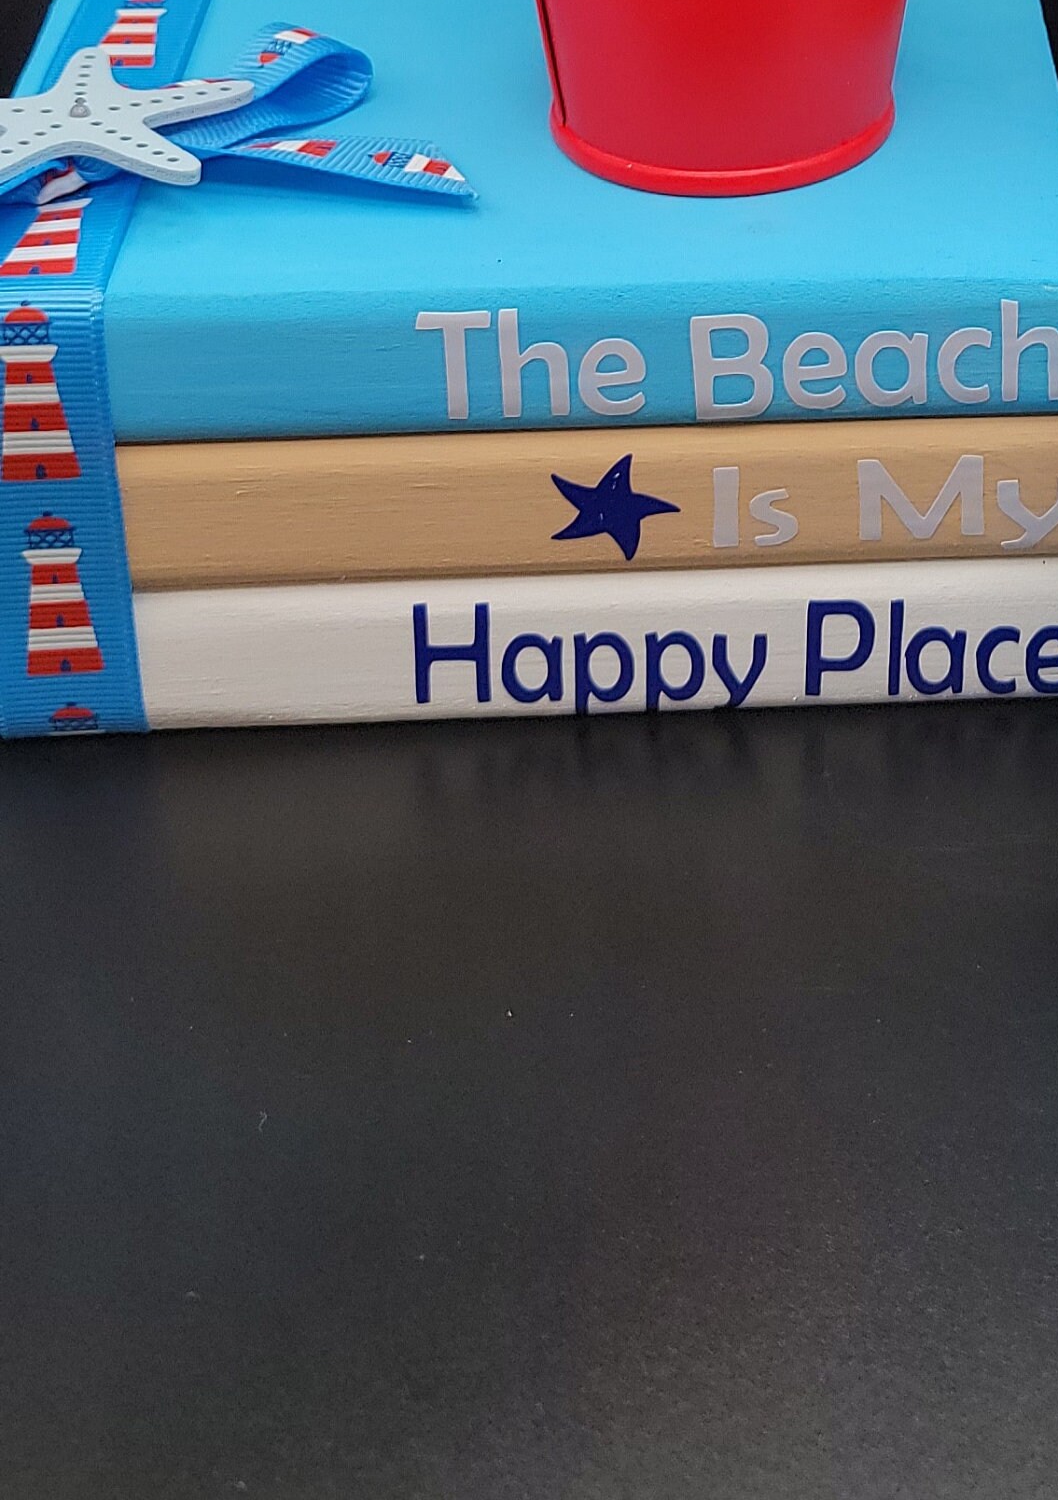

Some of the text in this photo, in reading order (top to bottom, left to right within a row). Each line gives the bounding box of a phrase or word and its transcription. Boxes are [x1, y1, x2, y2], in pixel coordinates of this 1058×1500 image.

[416, 308, 646, 420] The
[713, 466, 799, 547] Is
[412, 602, 767, 715] Happy
